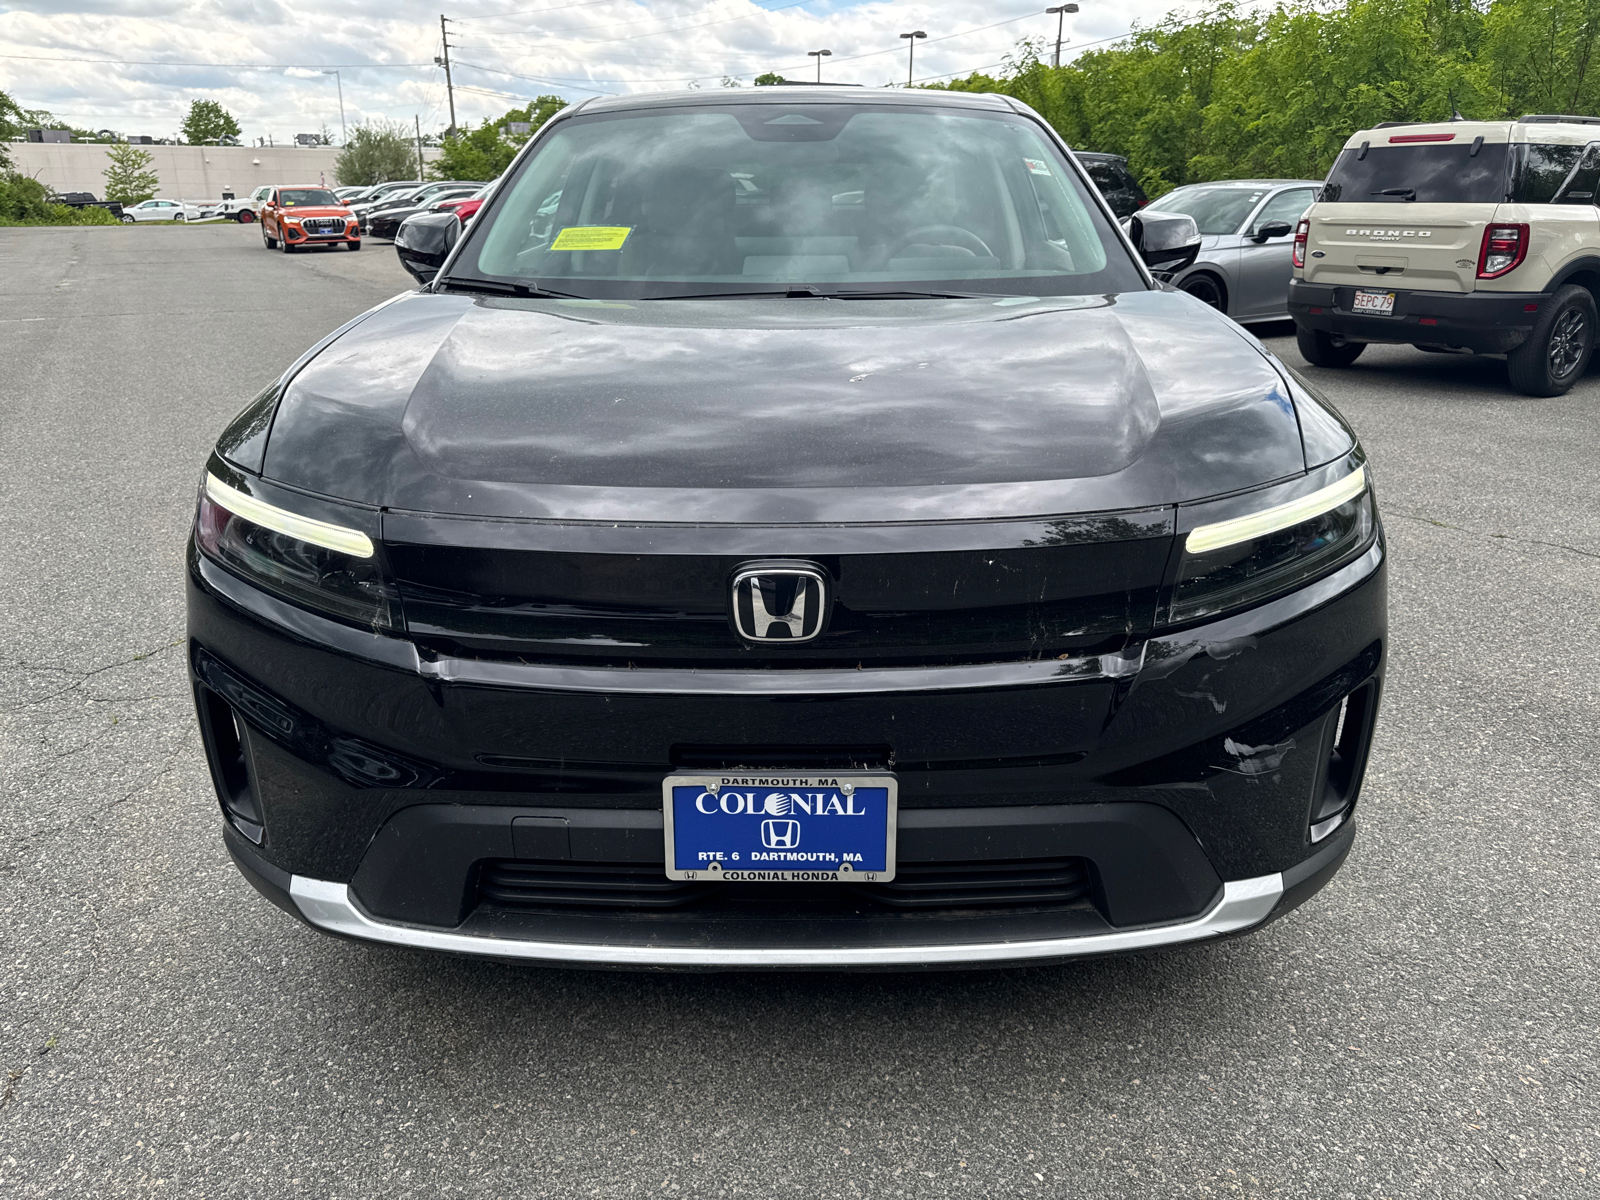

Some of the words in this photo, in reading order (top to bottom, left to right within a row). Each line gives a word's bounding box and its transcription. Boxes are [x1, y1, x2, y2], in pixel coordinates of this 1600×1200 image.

[1345, 229, 1432, 237] BRONCO
[721, 778, 813, 787] DARTMOUTH,
[818, 779, 839, 787] MA
[695, 792, 866, 816] COLONIAL
[698, 851, 728, 861] RTE.
[731, 851, 740, 861] 6
[751, 852, 839, 863] DARTMOUTH,
[842, 853, 864, 862] MA
[722, 871, 788, 881] COLONIAL
[791, 872, 839, 881] HONDA
